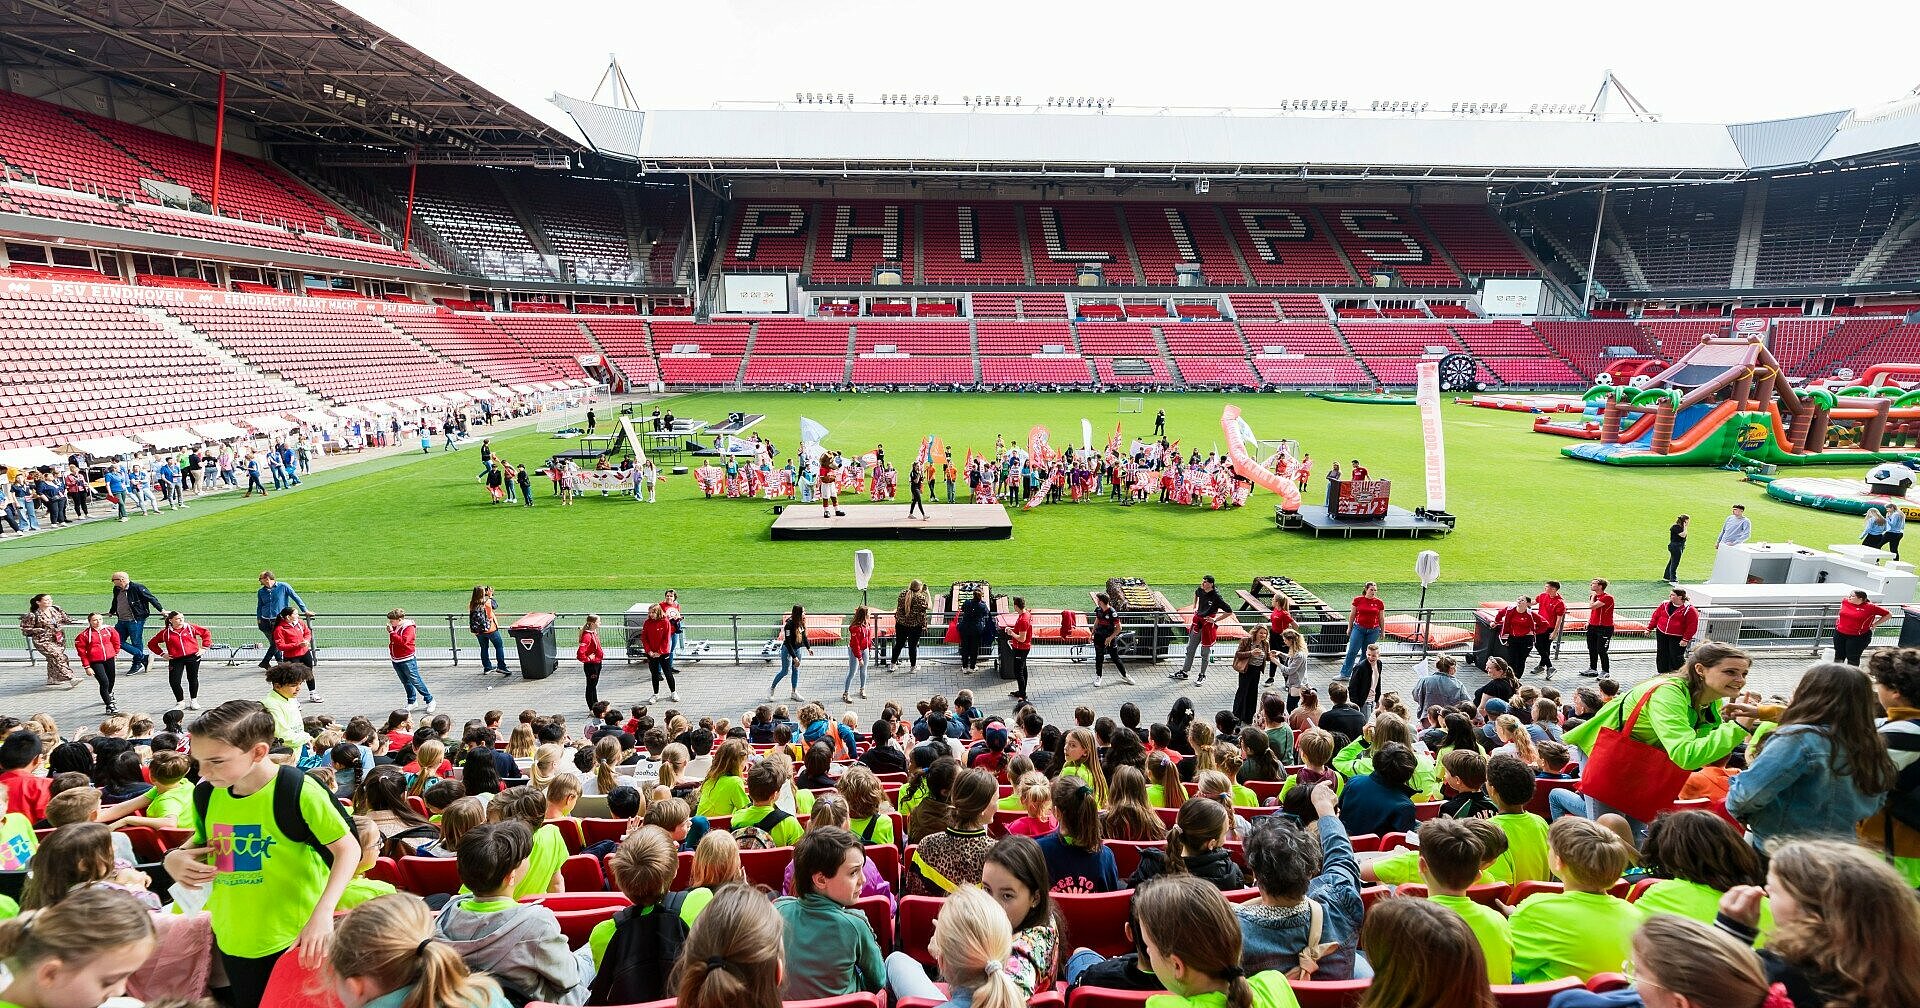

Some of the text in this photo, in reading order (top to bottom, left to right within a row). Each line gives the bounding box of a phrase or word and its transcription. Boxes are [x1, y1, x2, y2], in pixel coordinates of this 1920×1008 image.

[734, 204, 1428, 262] PHILIPS
[52, 283, 185, 300] PSV EINDHOVEN
[224, 293, 359, 311] EENDRACHT MAAKT MACHT
[383, 305, 437, 314] PSV EINDHOVEN
[1422, 418, 1442, 500] ROOD-WITTEN
[1078, 876, 1094, 890] TO
